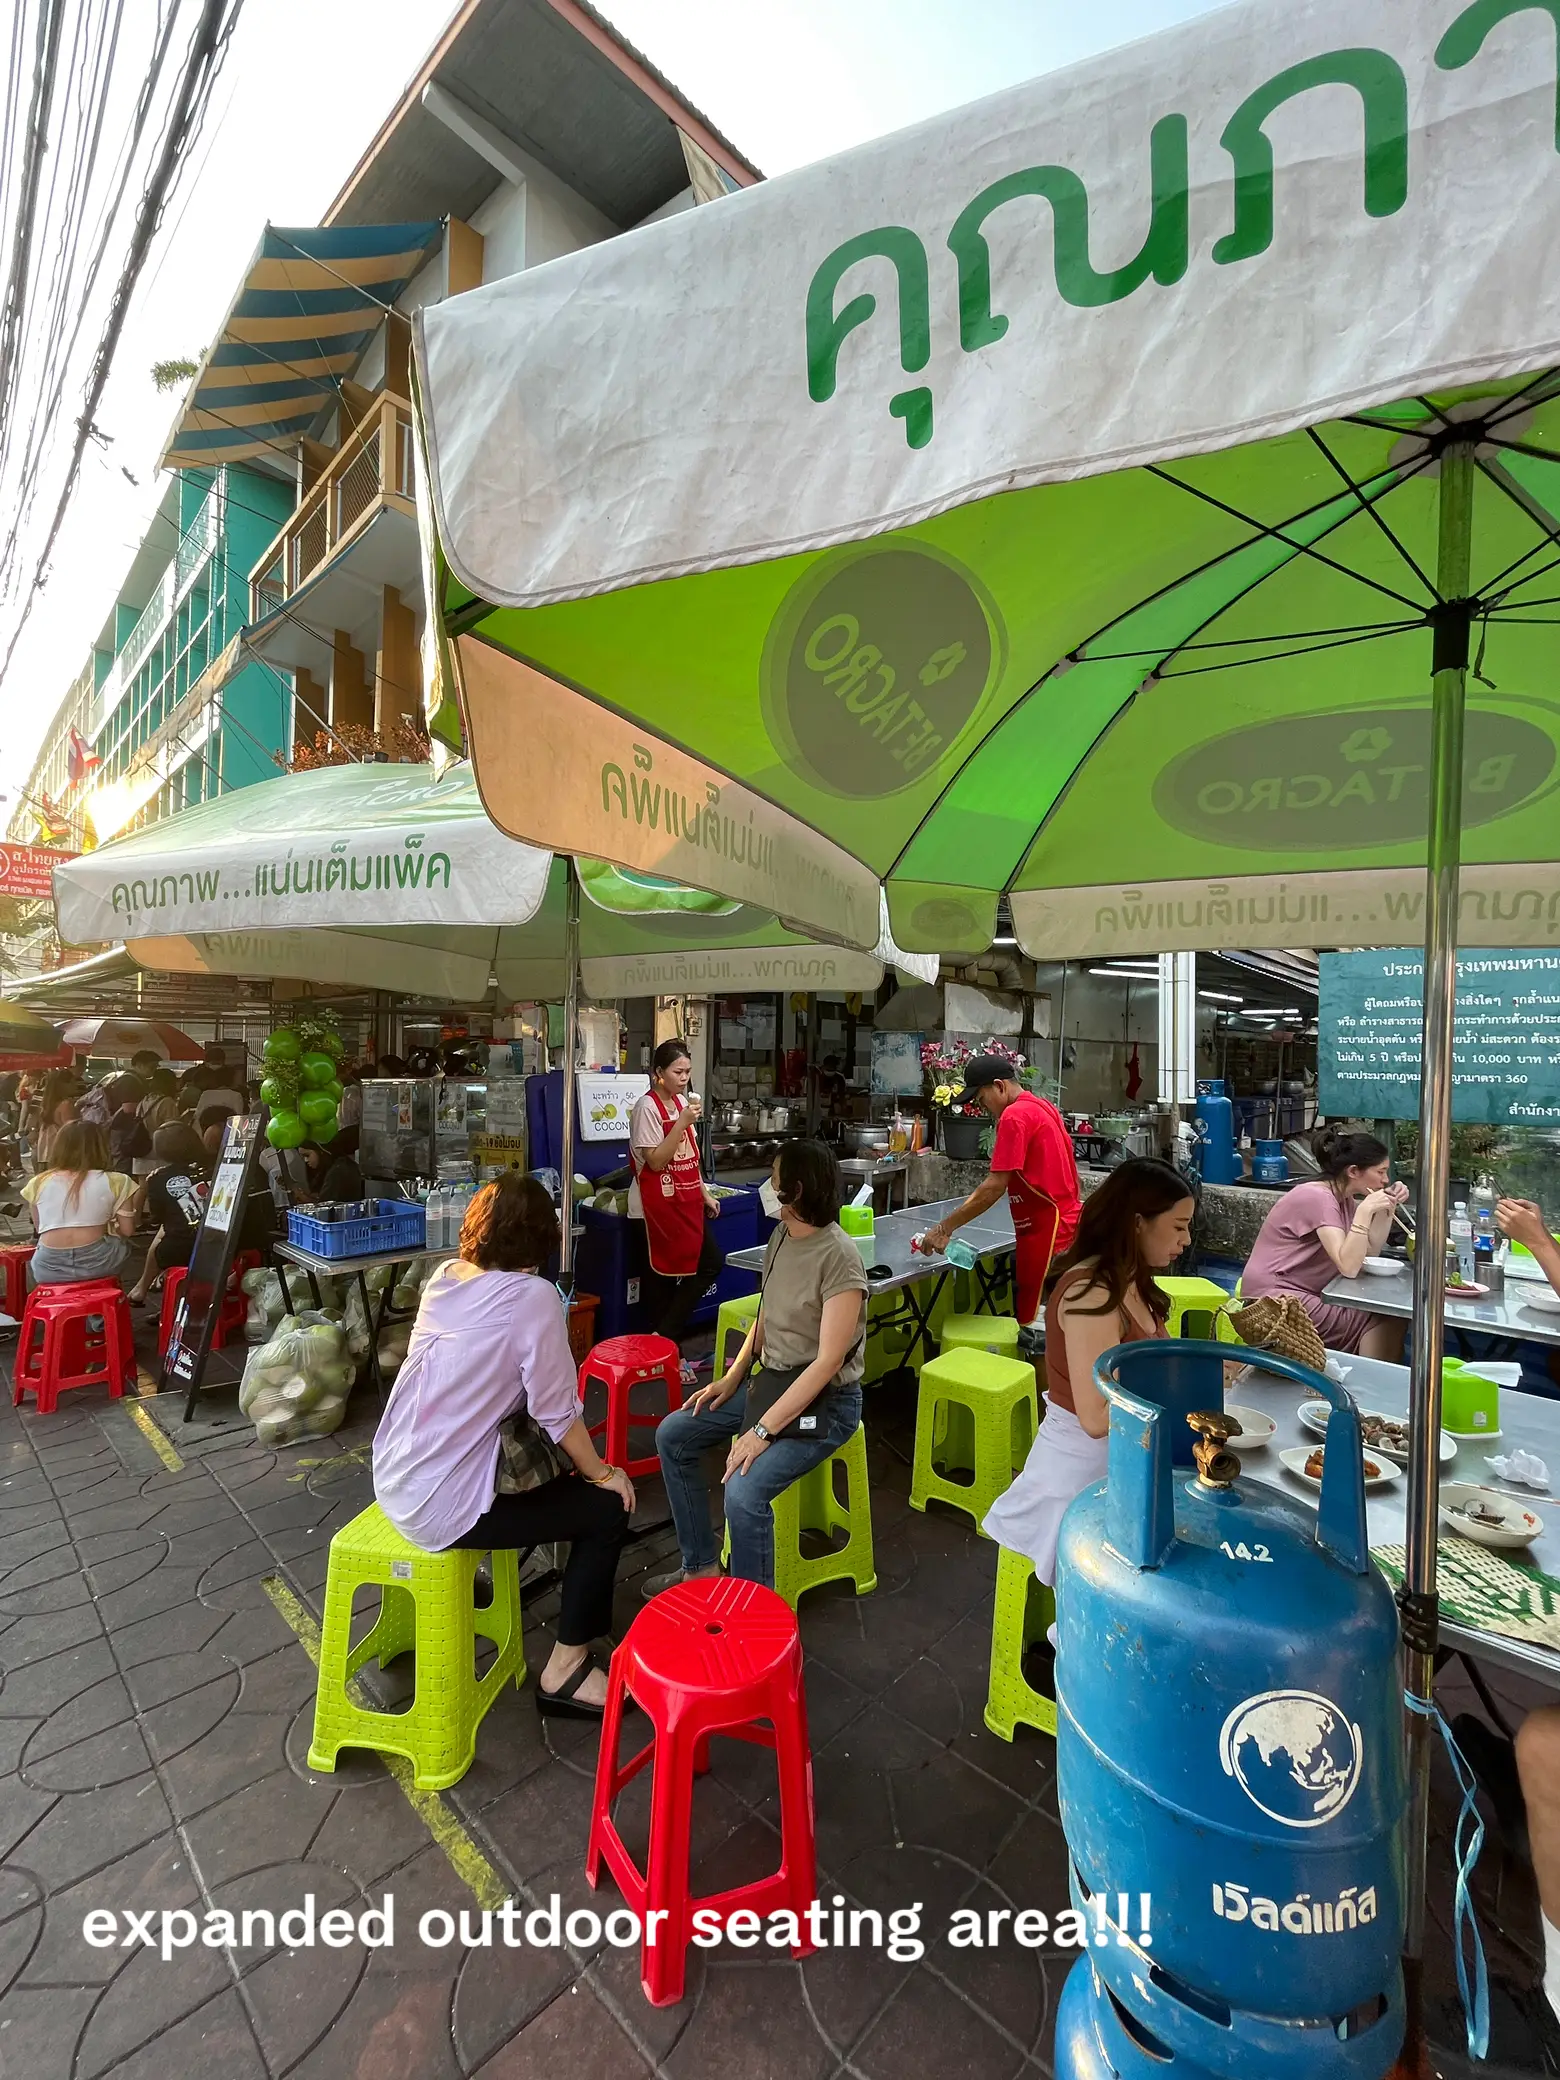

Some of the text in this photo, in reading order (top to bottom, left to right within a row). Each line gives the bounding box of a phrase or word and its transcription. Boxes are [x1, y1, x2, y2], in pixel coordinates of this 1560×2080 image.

[1455, 957, 1560, 978] รุงเทพมหาน
[1337, 1015, 1356, 1026] หรือ
[1336, 1051, 1365, 1062] ไม่เกิน
[1369, 1053, 1376, 1062] 5
[1380, 1051, 1389, 1062] ปี
[1471, 1054, 1511, 1065] 10,000
[1516, 1055, 1542, 1065] บาท
[1505, 1074, 1528, 1084] 360
[592, 1090, 619, 1100] มะพร้าว
